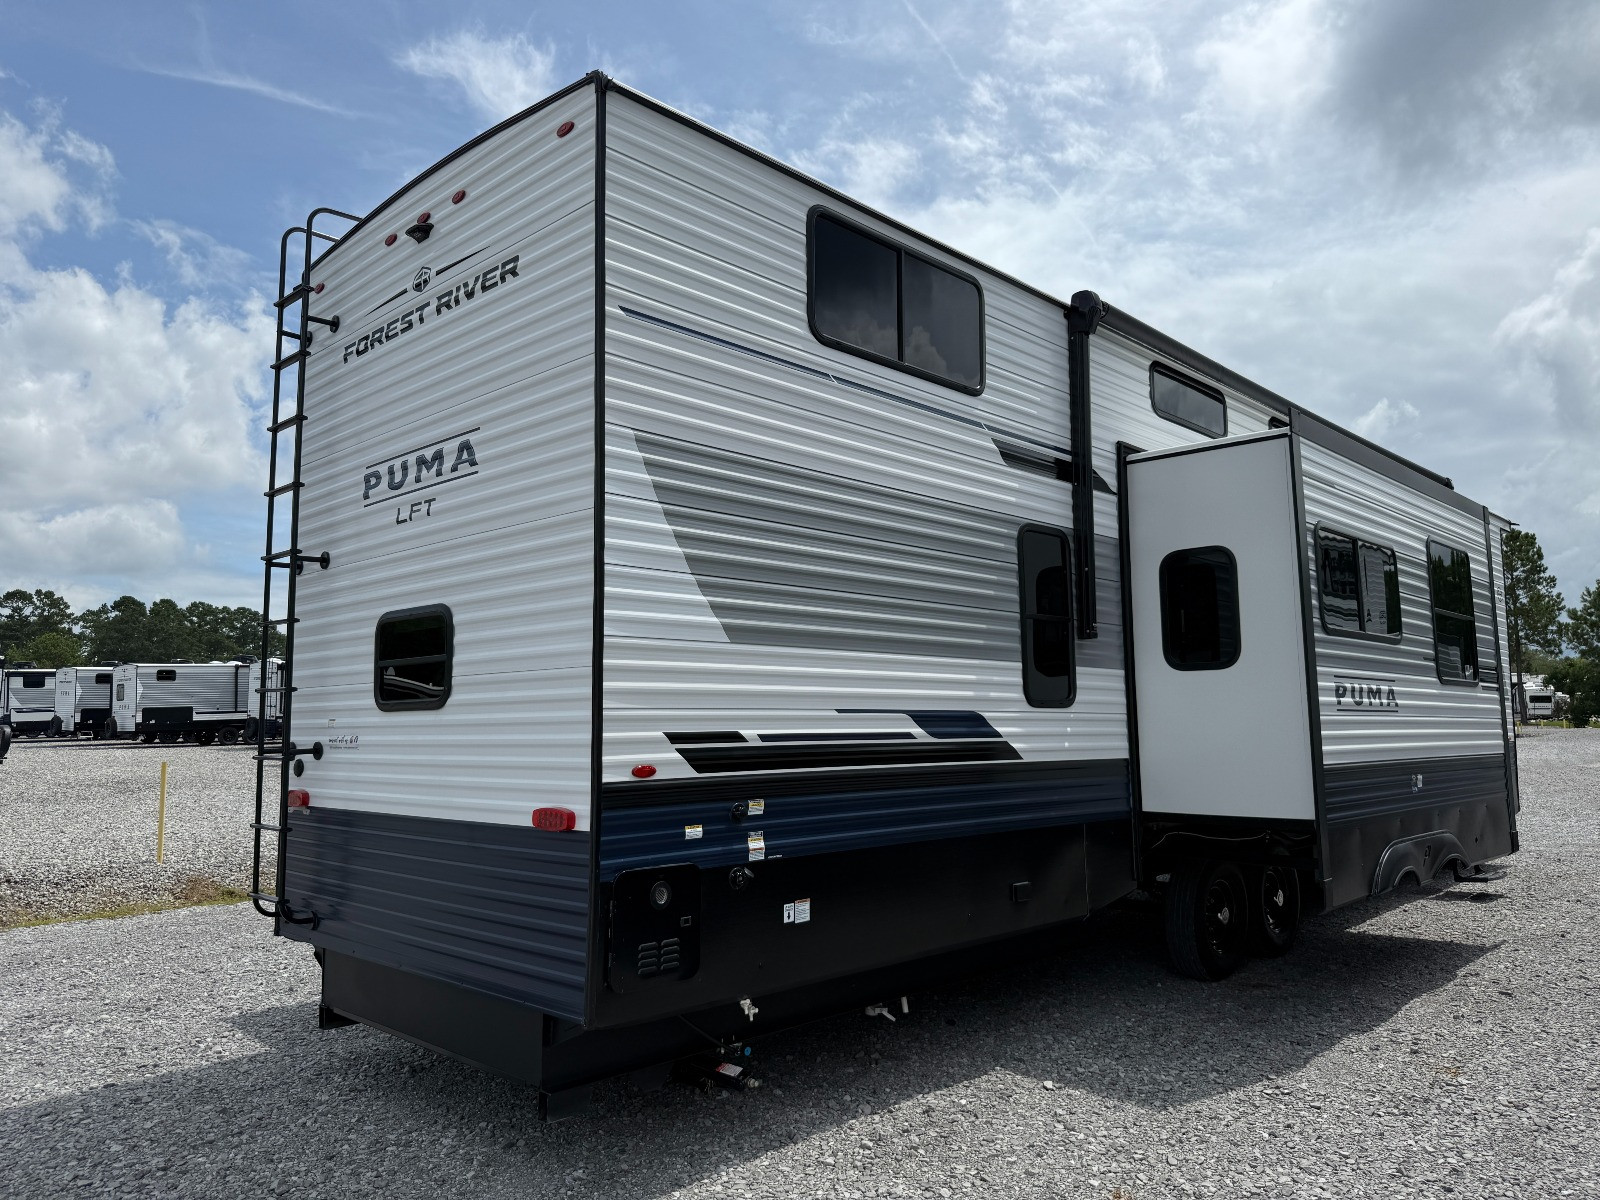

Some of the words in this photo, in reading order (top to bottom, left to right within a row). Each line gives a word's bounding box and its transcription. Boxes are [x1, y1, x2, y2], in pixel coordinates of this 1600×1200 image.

[343, 301, 431, 364] FOREST
[435, 254, 520, 316] RIVER
[363, 439, 479, 500] PUMA
[396, 498, 437, 525] LFT
[1334, 682, 1399, 707] PUMA
